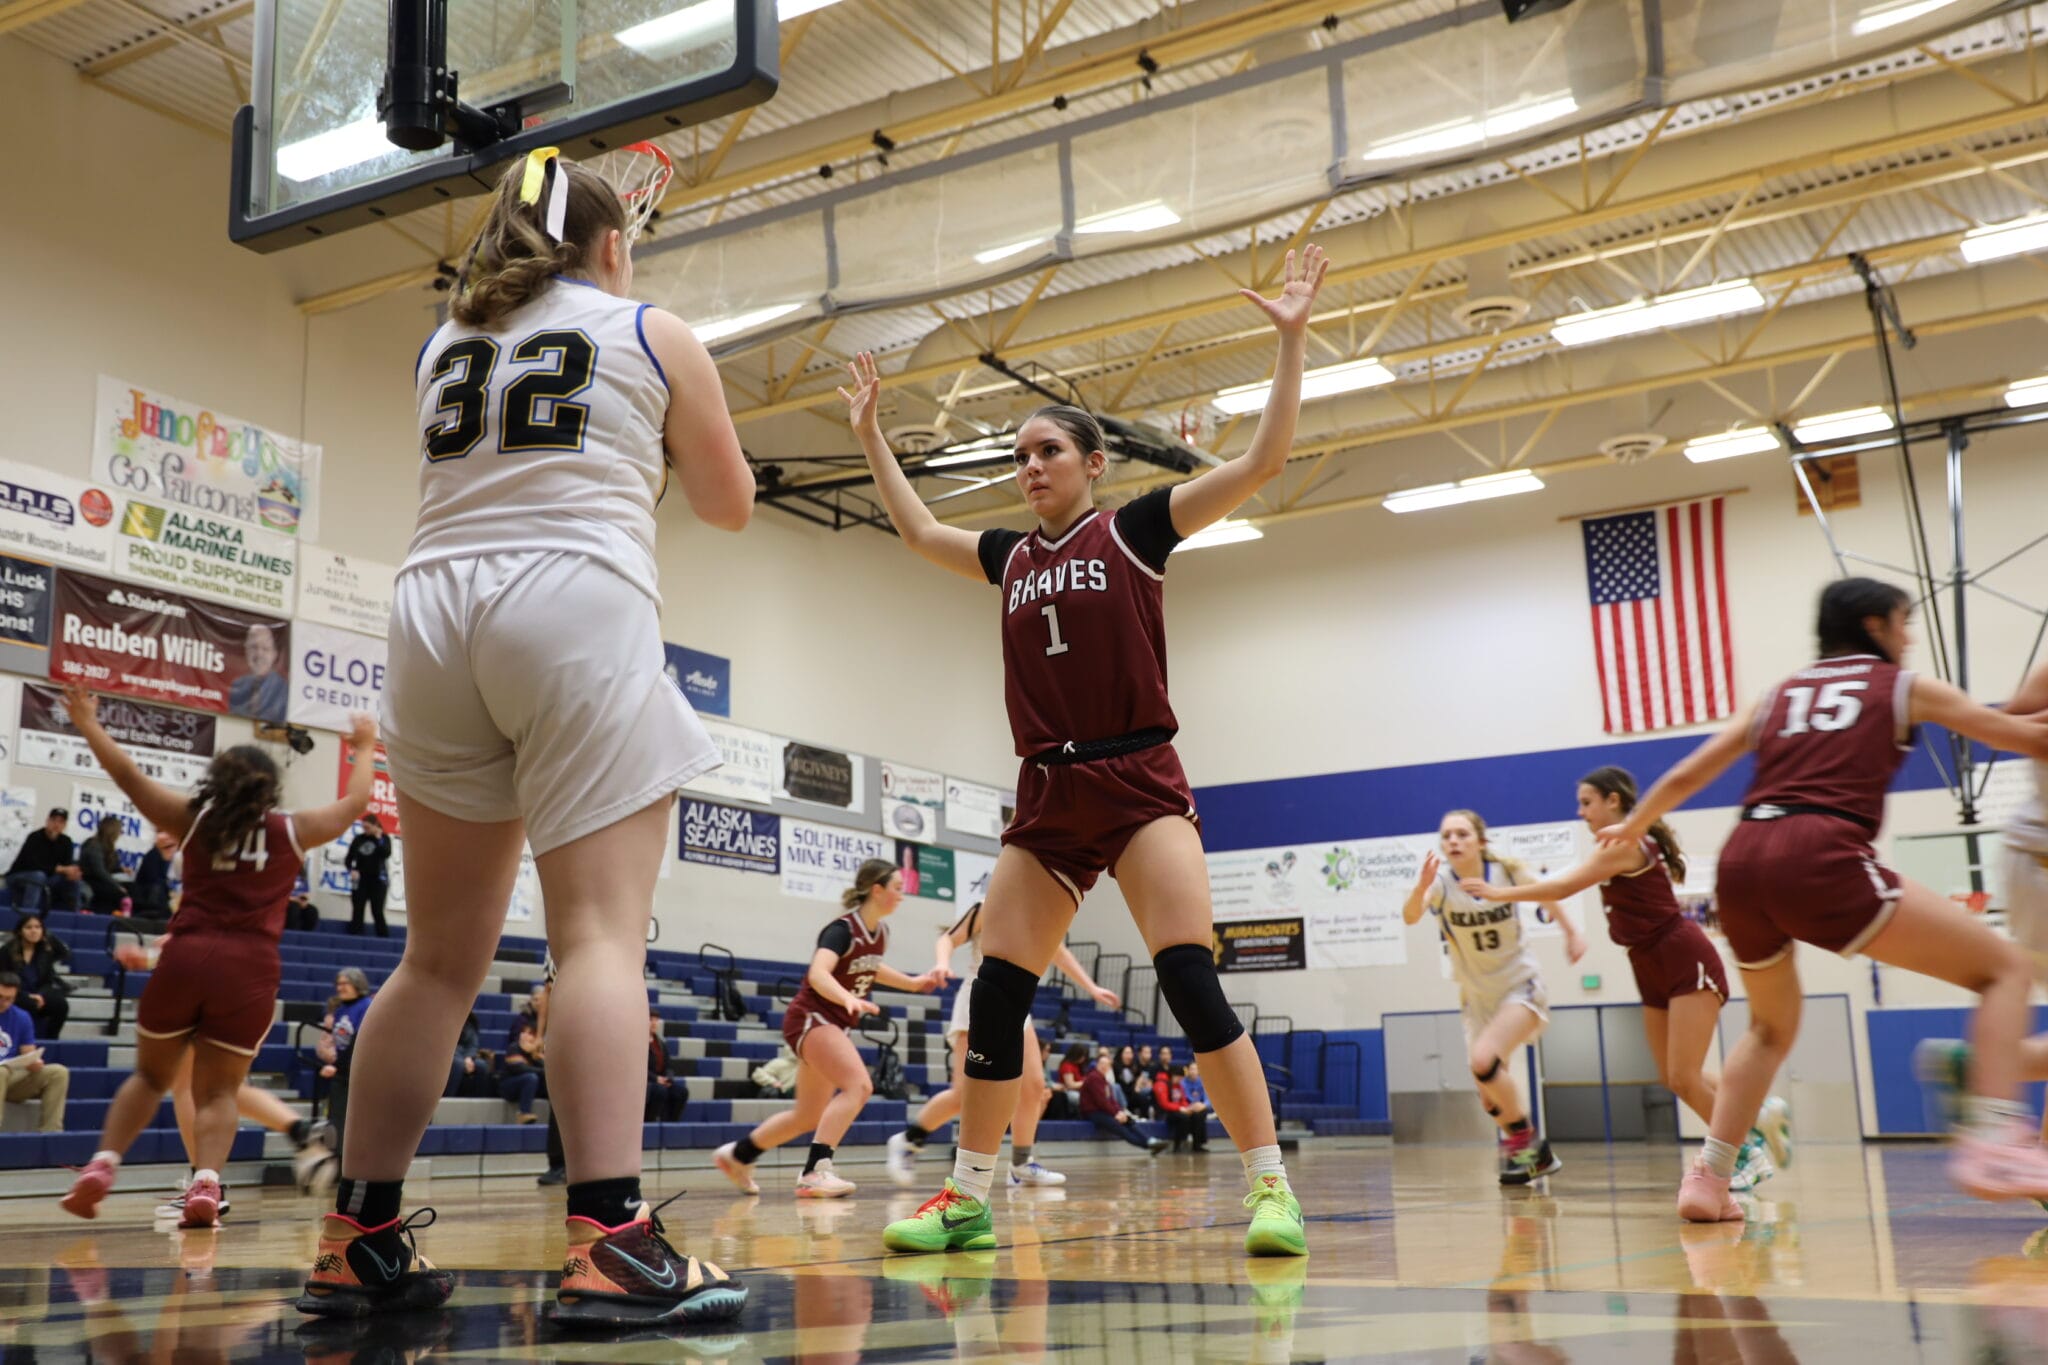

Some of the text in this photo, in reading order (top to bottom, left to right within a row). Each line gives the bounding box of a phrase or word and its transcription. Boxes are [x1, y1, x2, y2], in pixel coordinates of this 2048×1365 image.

[425, 328, 599, 463] 32
[167, 512, 244, 545] ALASKA
[163, 529, 293, 576] MARINE LINES
[5, 567, 46, 592] Luck
[129, 543, 283, 595] PROUD SUPPORTER
[1008, 558, 1107, 615] BRAVES
[63, 613, 225, 673] Reuben Willis
[1041, 604, 1069, 656] 1
[303, 685, 369, 710] CREDIT
[1777, 680, 1869, 738] 15
[129, 729, 162, 746] Estate
[163, 736, 194, 751] Group
[171, 712, 197, 738] 58
[685, 803, 753, 832] ALASKA
[212, 828, 269, 873] 24
[684, 825, 776, 858] SEAPLANES
[794, 827, 884, 857] SOUTHEAST
[787, 847, 825, 868] MINE
[1358, 853, 1417, 865] Radiation
[1359, 866, 1416, 879] Oncology
[1472, 929, 1500, 951] 13
